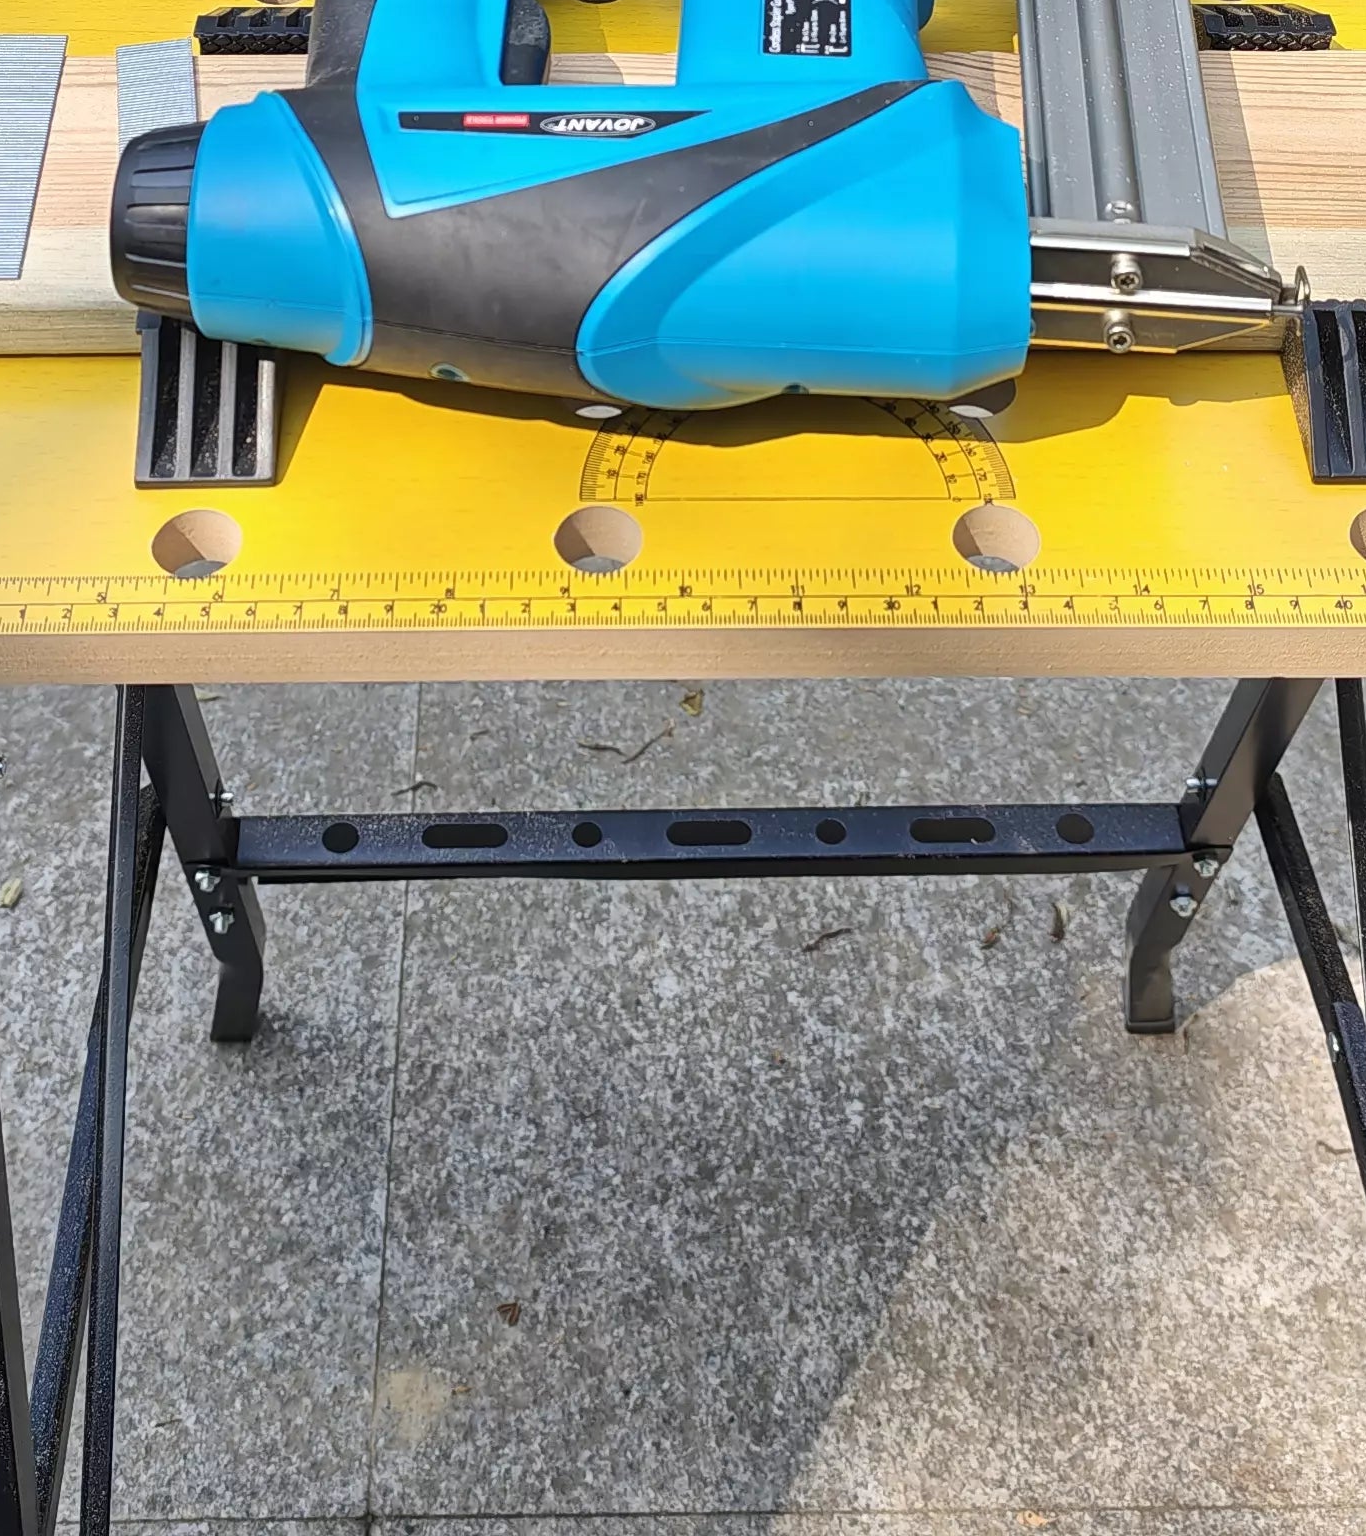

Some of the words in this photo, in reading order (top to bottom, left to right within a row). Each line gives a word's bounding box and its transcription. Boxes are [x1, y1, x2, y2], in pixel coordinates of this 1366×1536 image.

[553, 118, 645, 132] JOVANT
[96, 592, 106, 603] 5
[212, 591, 223, 602] 6
[330, 589, 340, 600] 7
[791, 585, 805, 595] 11
[905, 584, 922, 595] 12
[1019, 584, 1036, 595] 13
[1133, 584, 1150, 595] 14
[1247, 584, 1264, 595] 15
